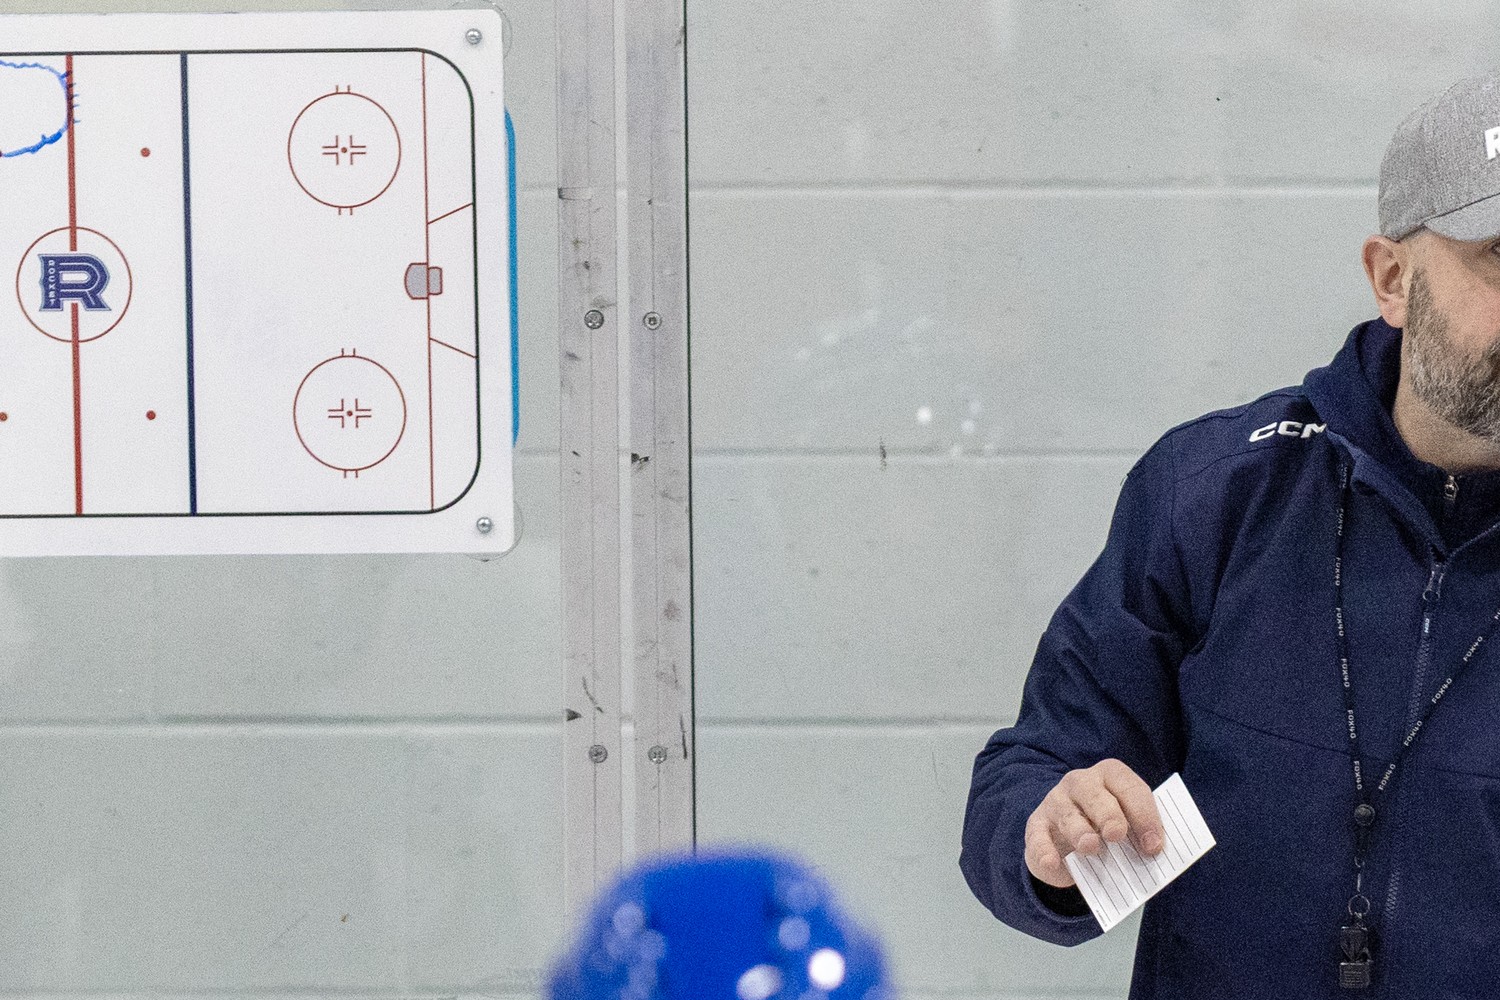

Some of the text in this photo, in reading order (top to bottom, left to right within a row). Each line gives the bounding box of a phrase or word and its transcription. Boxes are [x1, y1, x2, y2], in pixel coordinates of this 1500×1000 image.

[1249, 420, 1327, 442] CCM
[1431, 677, 1453, 704] FOX40
[1347, 709, 1357, 739] FOX40
[1403, 720, 1423, 747] FOX40
[1378, 763, 1396, 790] FOX40
